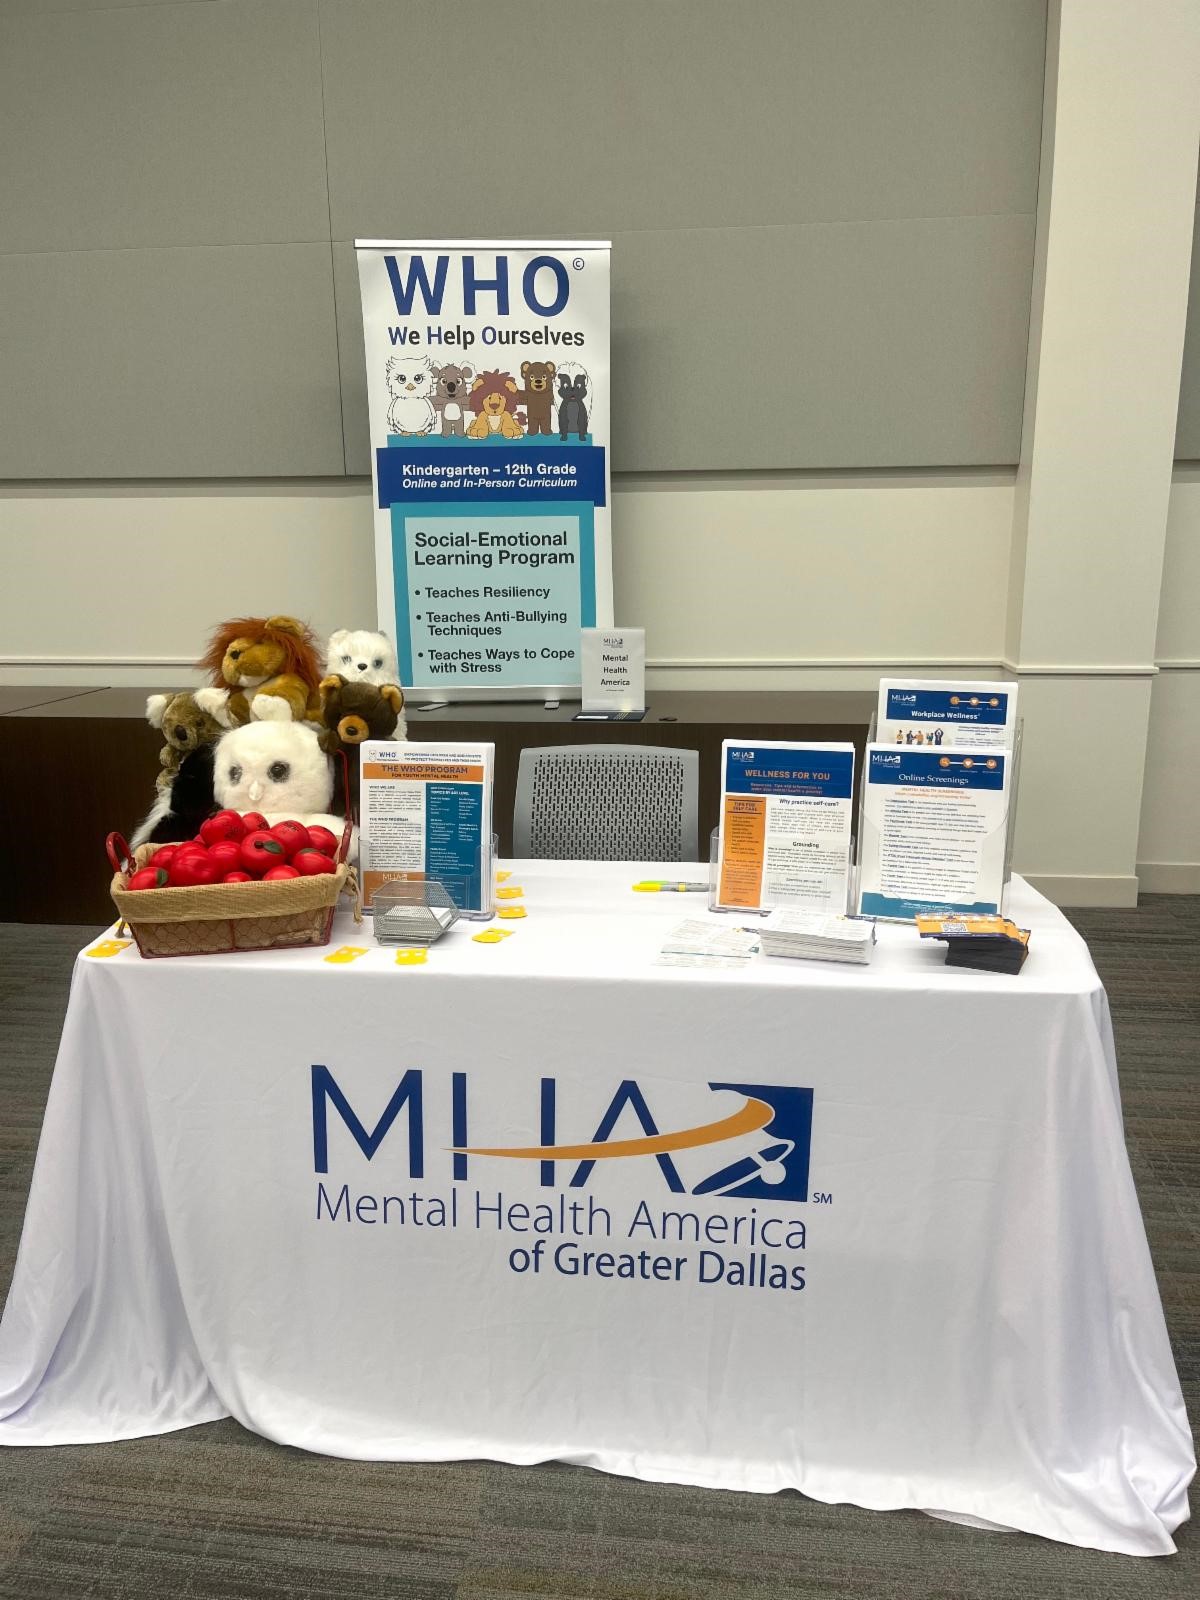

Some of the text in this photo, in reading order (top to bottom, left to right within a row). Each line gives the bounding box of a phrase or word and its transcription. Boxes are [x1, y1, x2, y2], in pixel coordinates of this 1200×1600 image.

[384, 256, 569, 317] WHO
[388, 325, 584, 350] We Help Ourselves
[402, 464, 489, 477] Kindergarten
[505, 464, 532, 475] 12th
[537, 463, 576, 474] Grade
[402, 477, 577, 488] Online and In-Person Curriculum
[415, 531, 567, 548] Social-Emotional
[415, 550, 575, 568] Learning Program
[425, 586, 550, 600] Teaches Resiliency
[426, 610, 567, 624] Teaches Anti-Bullying
[427, 625, 502, 638] Techniques
[428, 648, 575, 662] Teaches Ways to Cope
[430, 662, 502, 673] with Stress
[745, 770, 790, 778] WELLNESS
[898, 773, 969, 784] Online Screenings
[813, 1192, 832, 1205] SM
[316, 1183, 807, 1250] Mental Health America
[509, 1240, 806, 1291] of Greater Dallas
